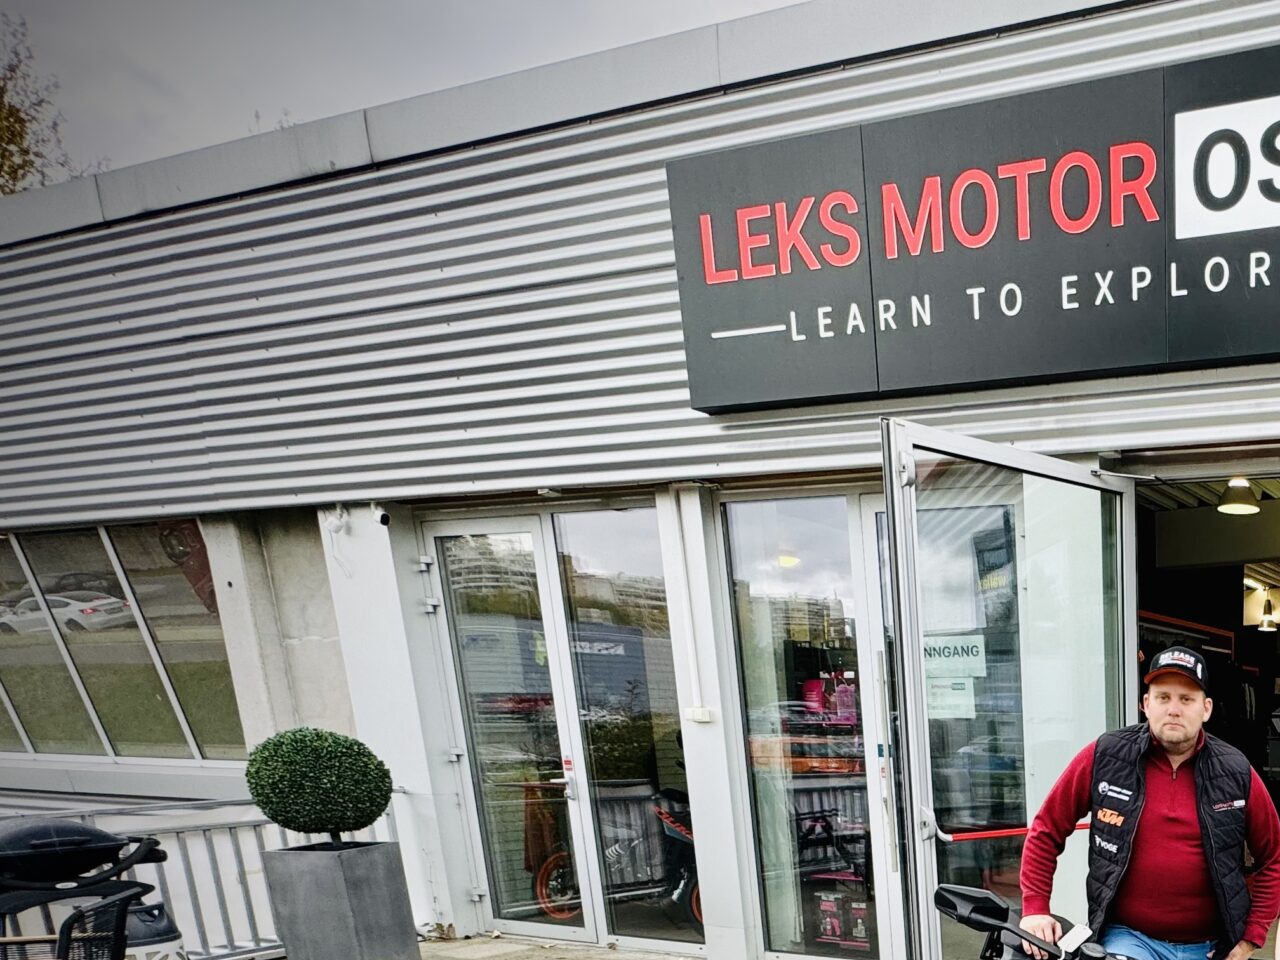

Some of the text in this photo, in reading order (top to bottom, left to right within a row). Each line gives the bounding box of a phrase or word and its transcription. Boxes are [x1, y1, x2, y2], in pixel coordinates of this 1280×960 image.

[699, 190, 862, 286] LEKS
[881, 142, 1160, 260] MOTOR
[790, 295, 931, 342] LEARN
[966, 282, 1023, 319] TO
[924, 645, 980, 658] NNGANG
[1097, 808, 1125, 827] KTM
